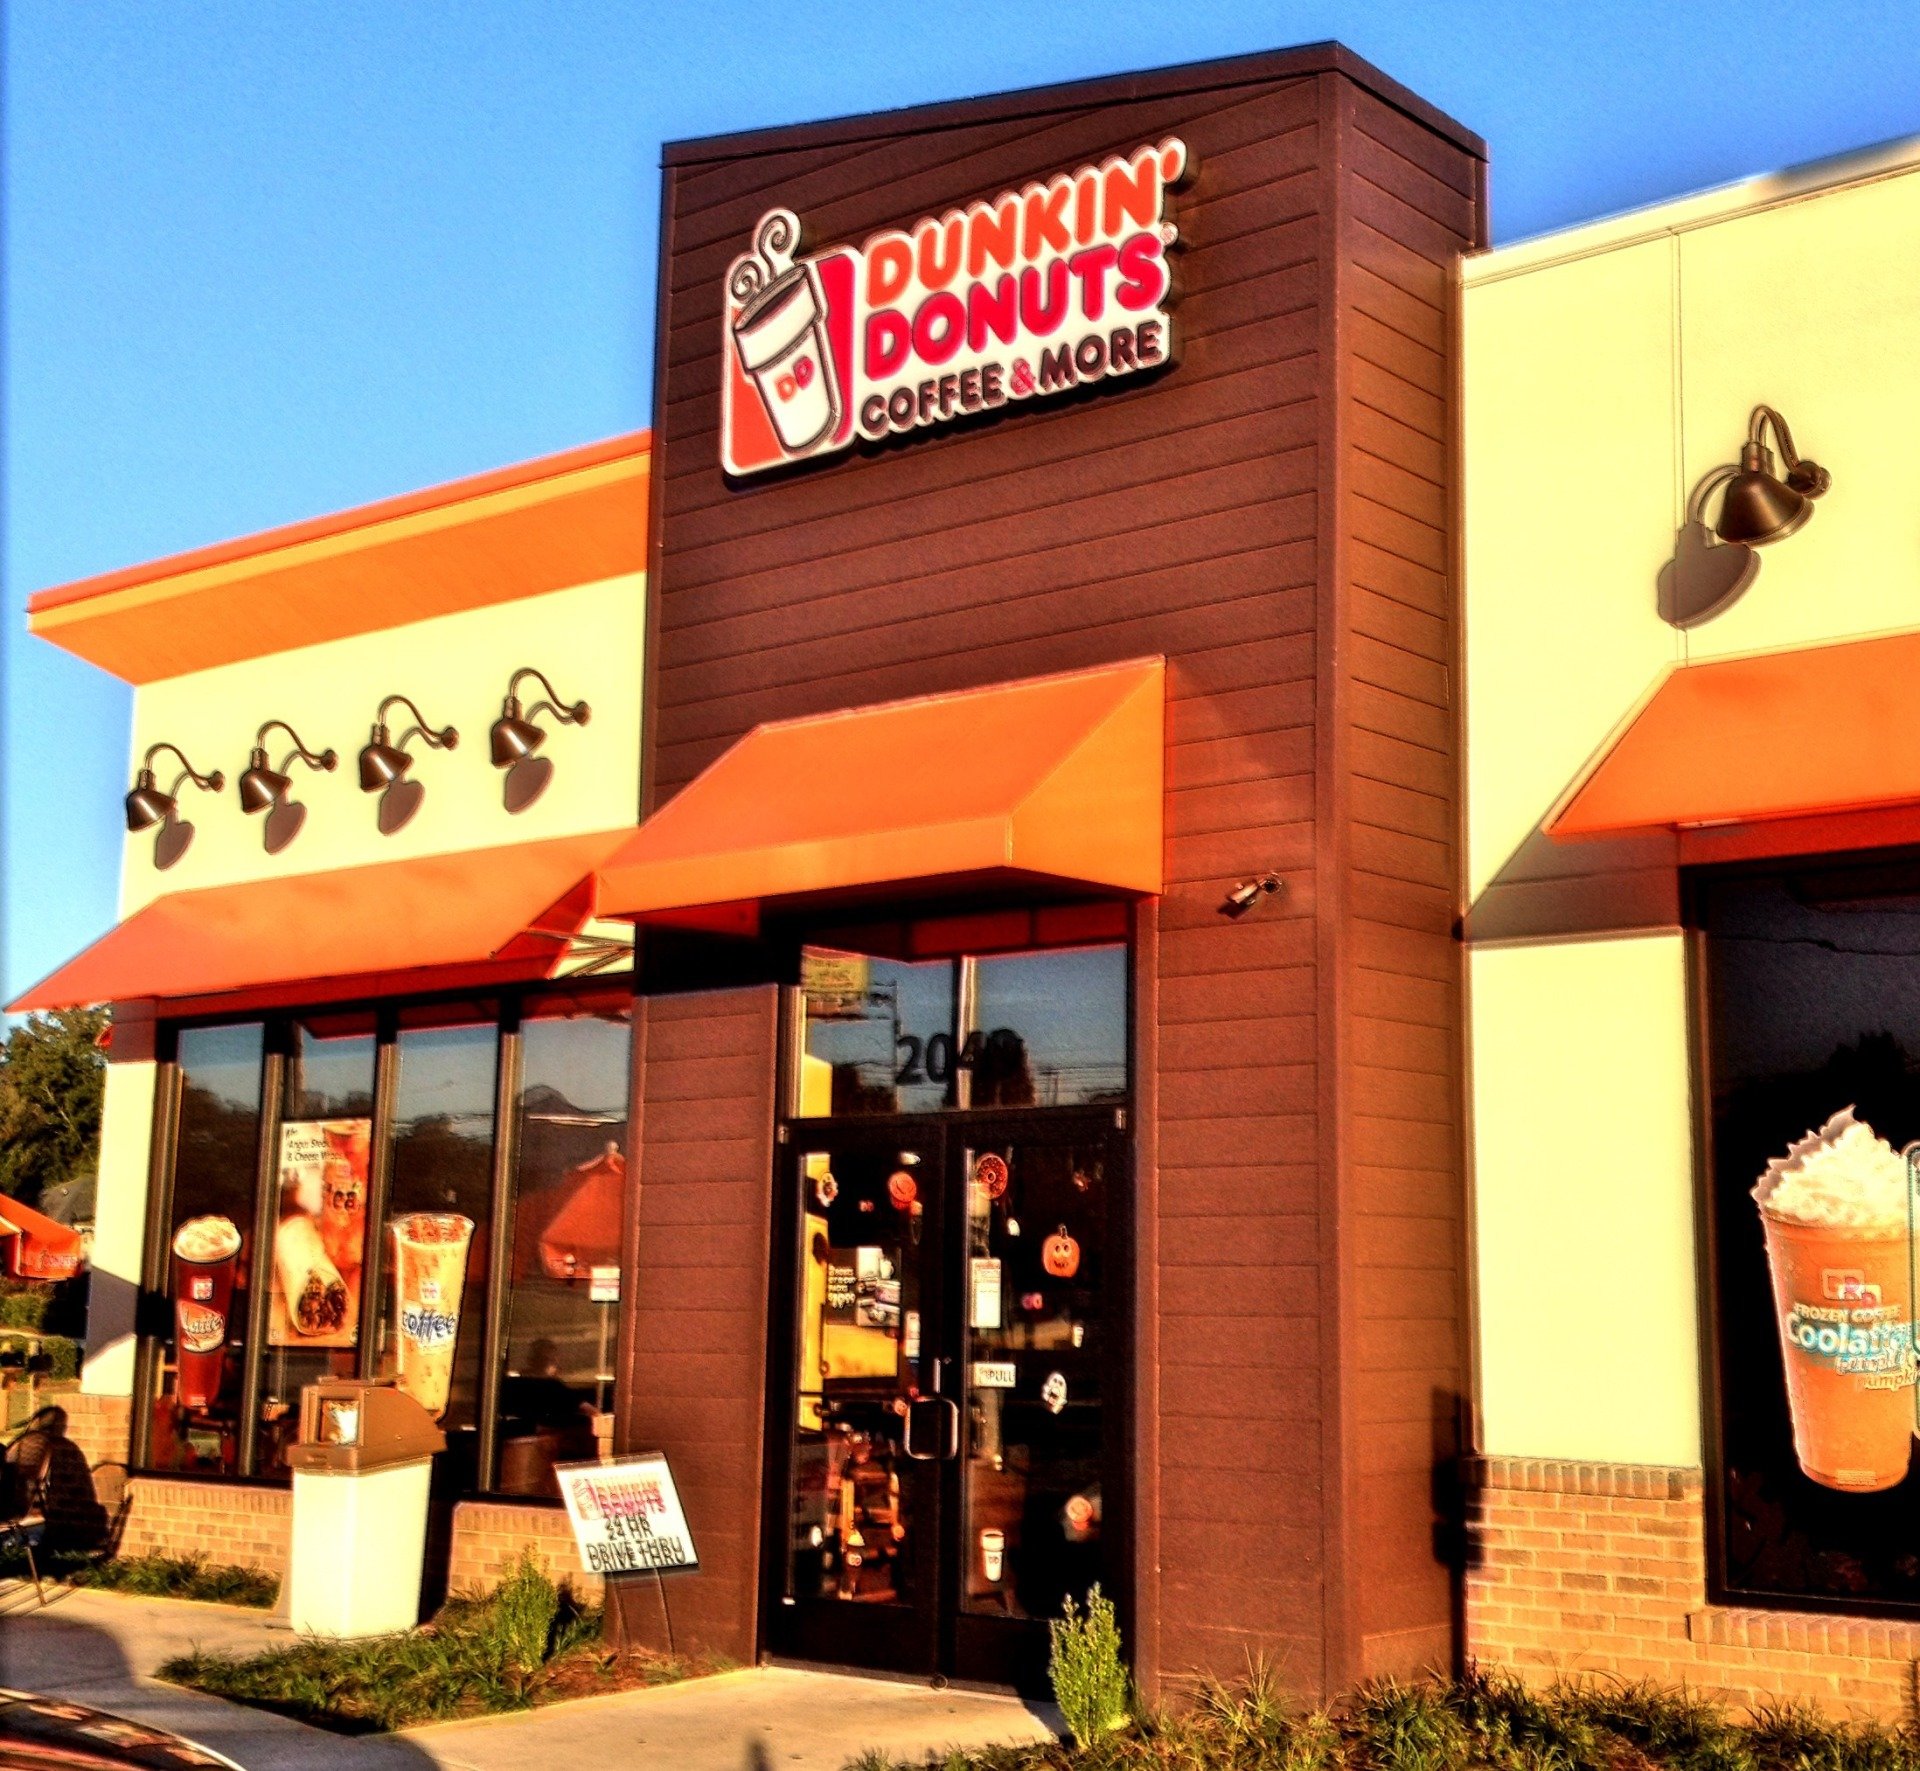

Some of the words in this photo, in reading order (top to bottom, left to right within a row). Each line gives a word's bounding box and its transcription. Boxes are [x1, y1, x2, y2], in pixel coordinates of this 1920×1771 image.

[866, 148, 1182, 308] DUNKIN'
[864, 232, 1165, 382] DONUTS
[774, 355, 815, 403] DD
[861, 363, 1006, 433] COFFEE
[1010, 358, 1037, 395] &
[1038, 320, 1164, 391] MORE
[586, 1540, 639, 1571] DRIVE
[636, 1536, 686, 1567] THRU
